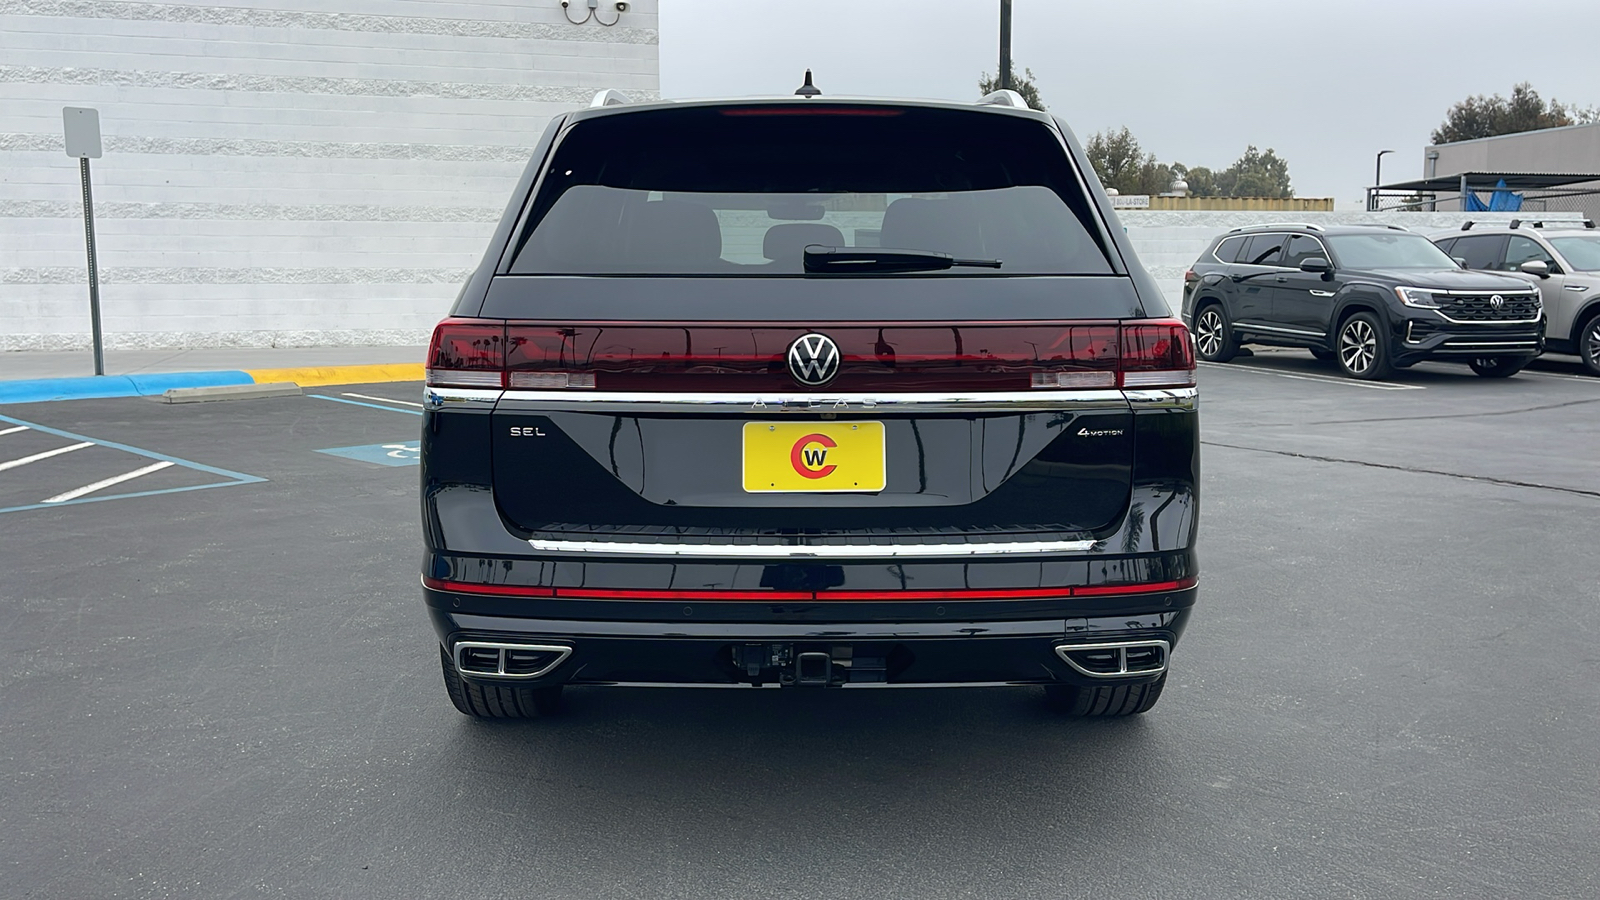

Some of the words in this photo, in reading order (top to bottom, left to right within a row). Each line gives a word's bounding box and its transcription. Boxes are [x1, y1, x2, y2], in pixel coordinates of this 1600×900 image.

[790, 335, 839, 383] VW
[751, 397, 877, 409] ATLAS
[510, 427, 546, 436] SEL
